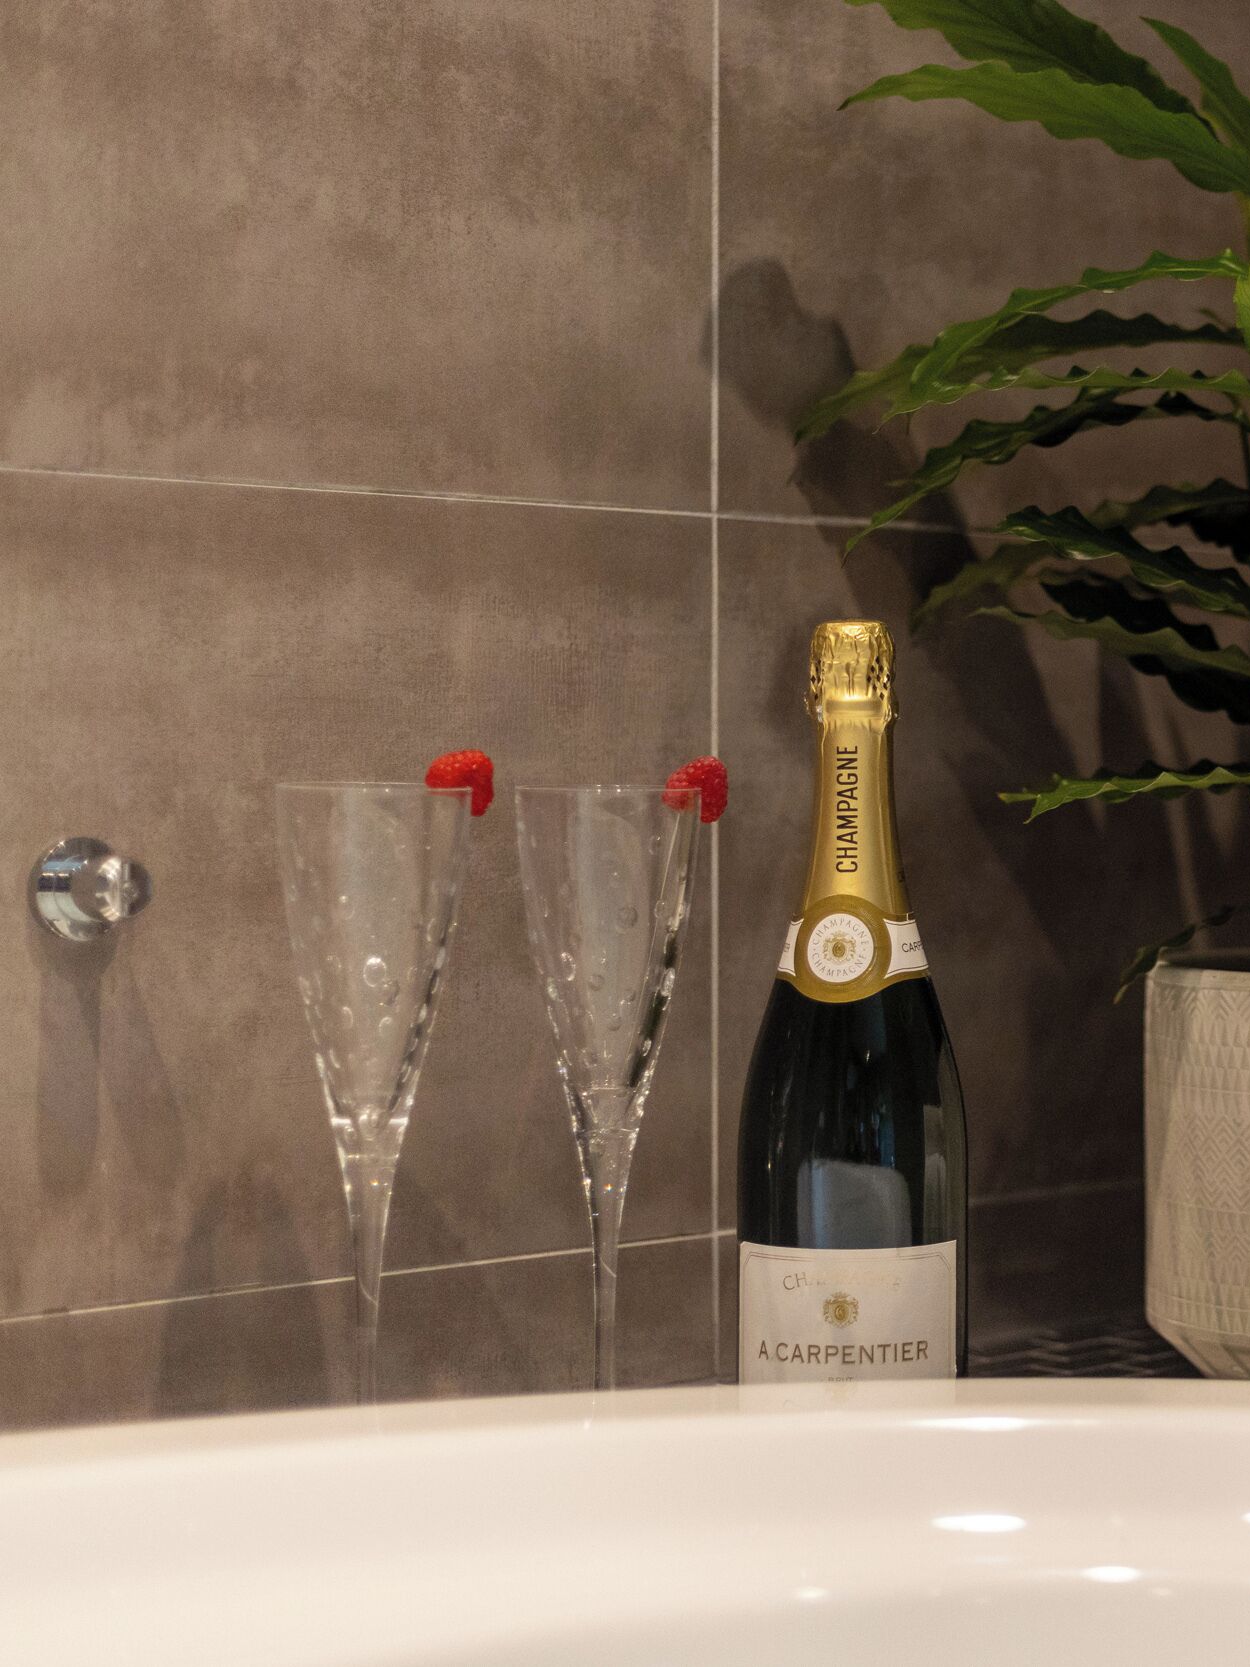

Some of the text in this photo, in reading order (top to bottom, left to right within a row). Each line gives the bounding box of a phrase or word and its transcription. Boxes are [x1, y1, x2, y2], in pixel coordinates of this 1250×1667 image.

[836, 745, 859, 873] CHAMPAGNE
[812, 919, 870, 946] CHAMPAGNE
[811, 952, 868, 977] CHAMPAGNE
[776, 1340, 929, 1364] CARPENTIER
